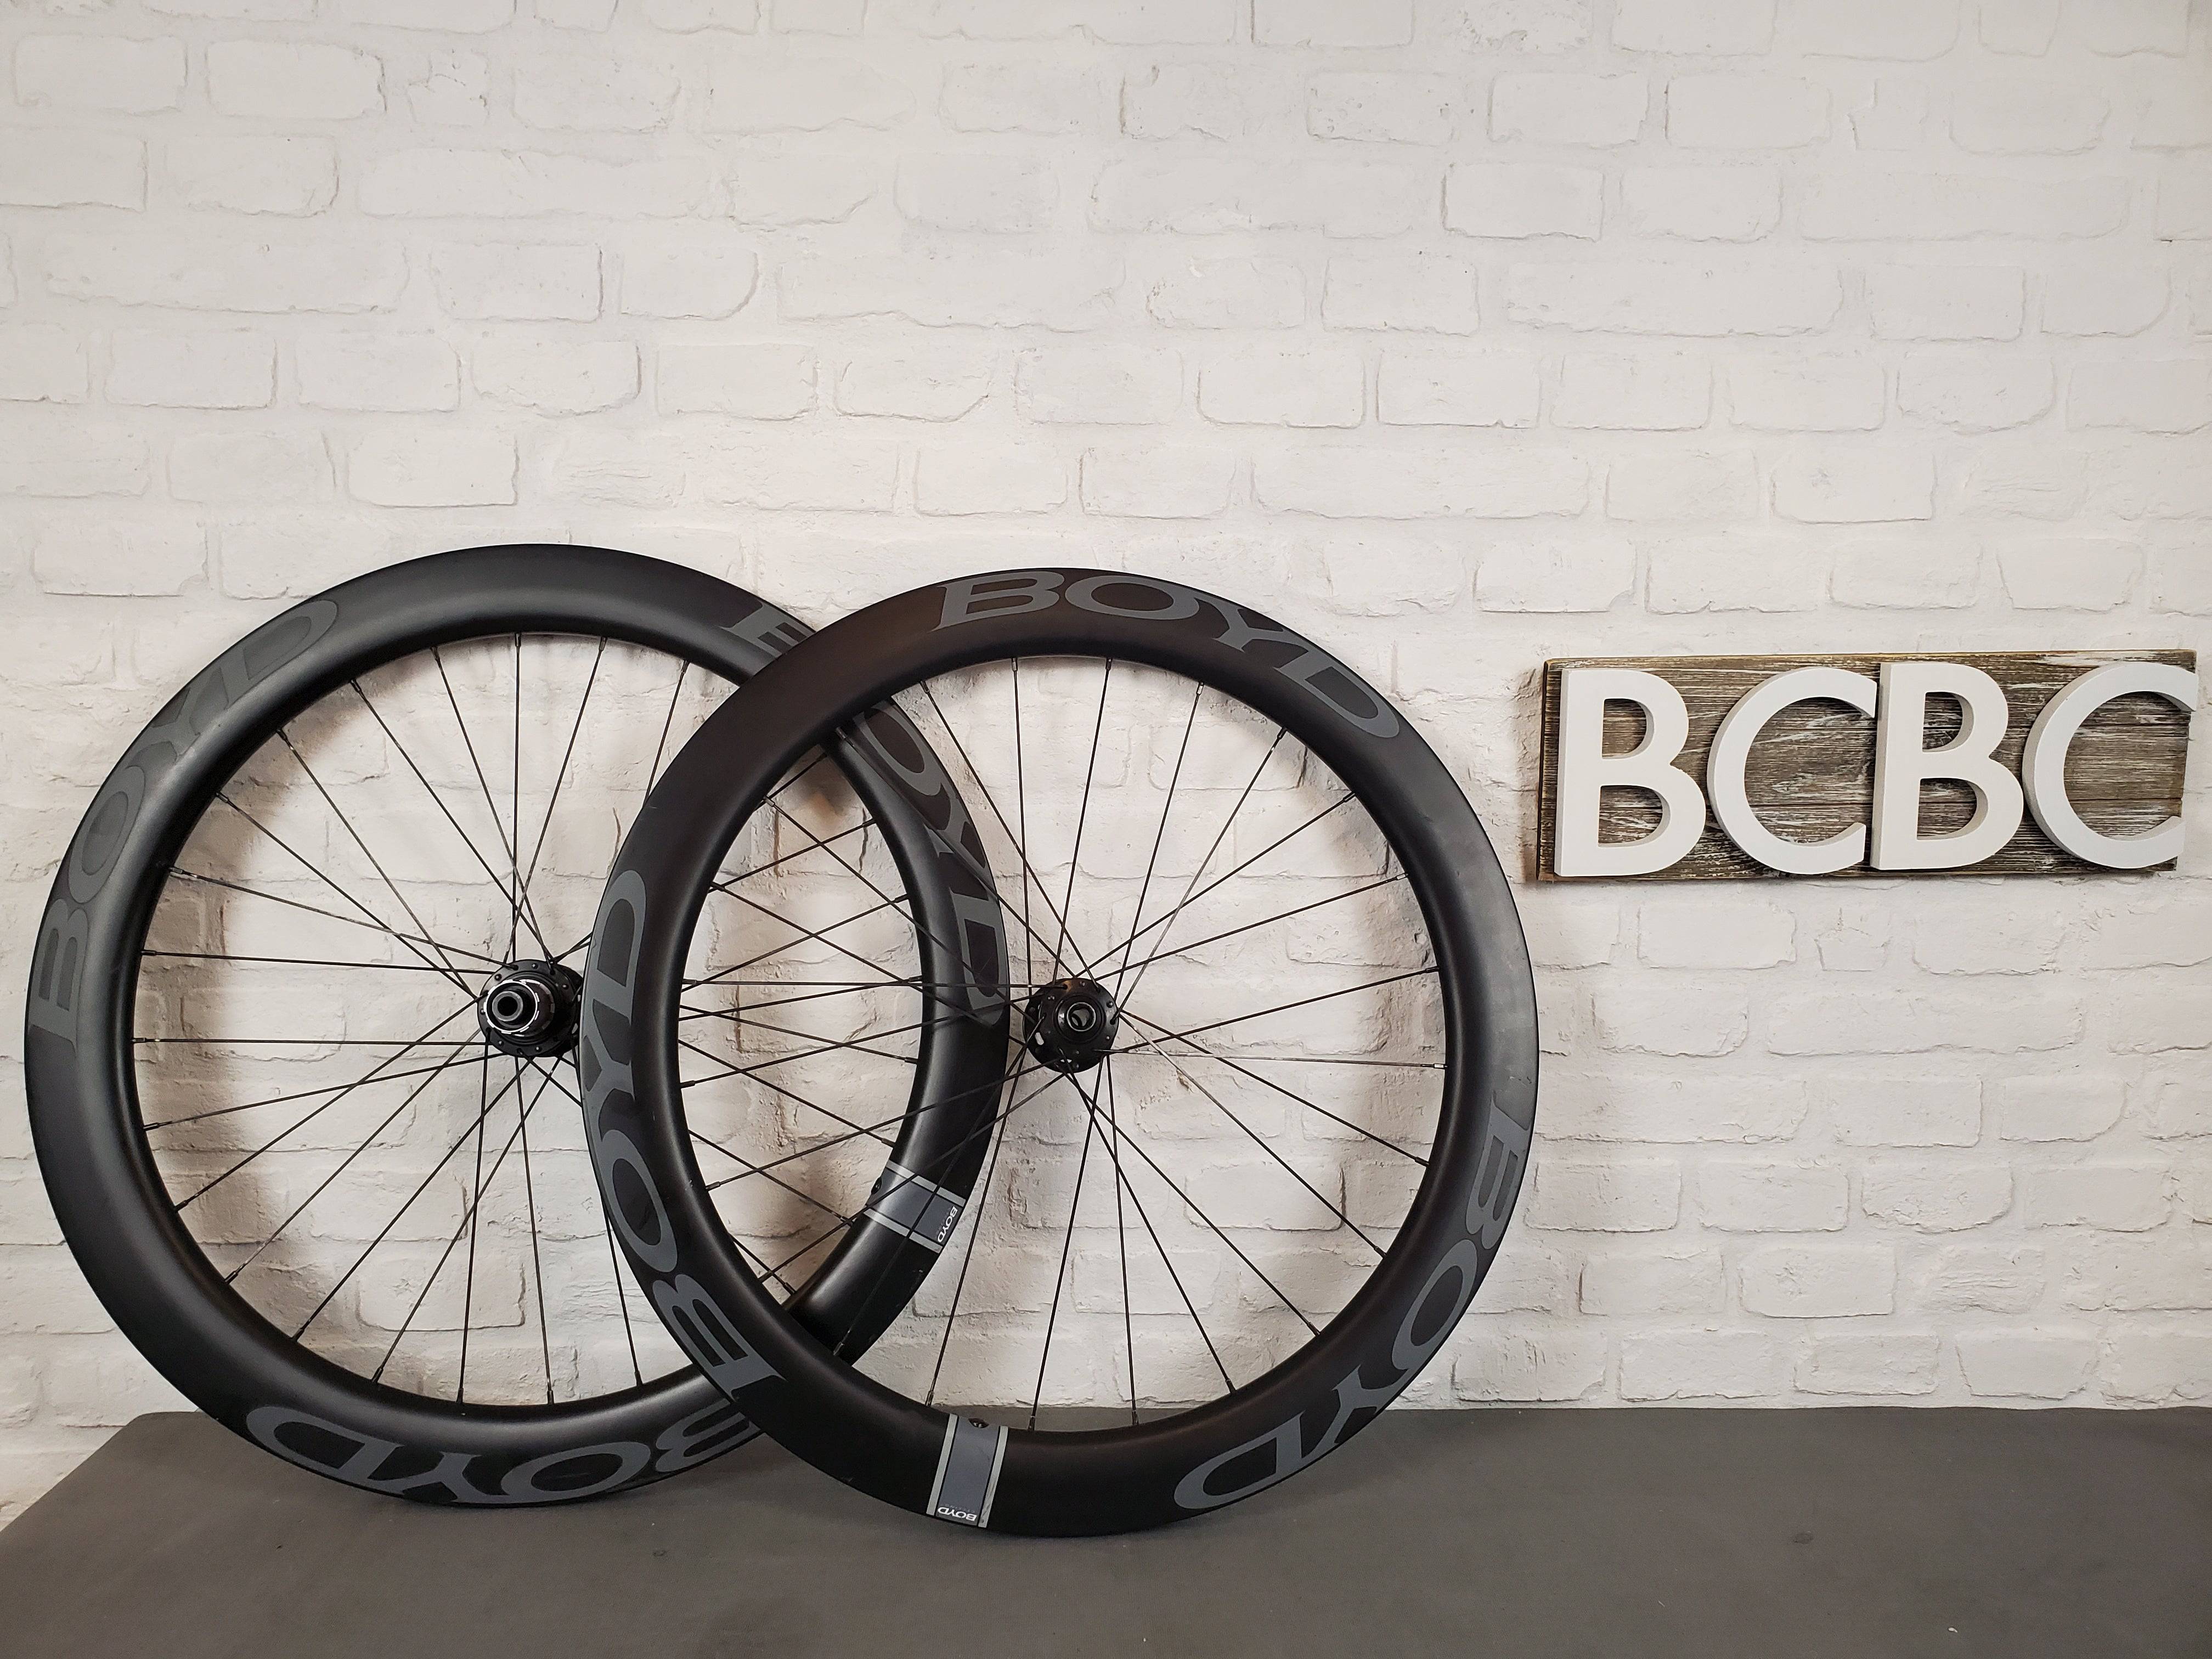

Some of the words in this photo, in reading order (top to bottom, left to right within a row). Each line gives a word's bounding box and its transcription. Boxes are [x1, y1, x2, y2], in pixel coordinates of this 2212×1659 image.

[932, 571, 1400, 738] BOYD
[27, 599, 338, 1057] BOYD
[1554, 661, 2198, 877] BCBC
[580, 869, 788, 1403] BOYD
[937, 1206, 958, 1243] BOYD
[1173, 1095, 1531, 1509] BOYD
[245, 1398, 761, 1504] BOYD
[938, 1506, 977, 1521] BOYD
